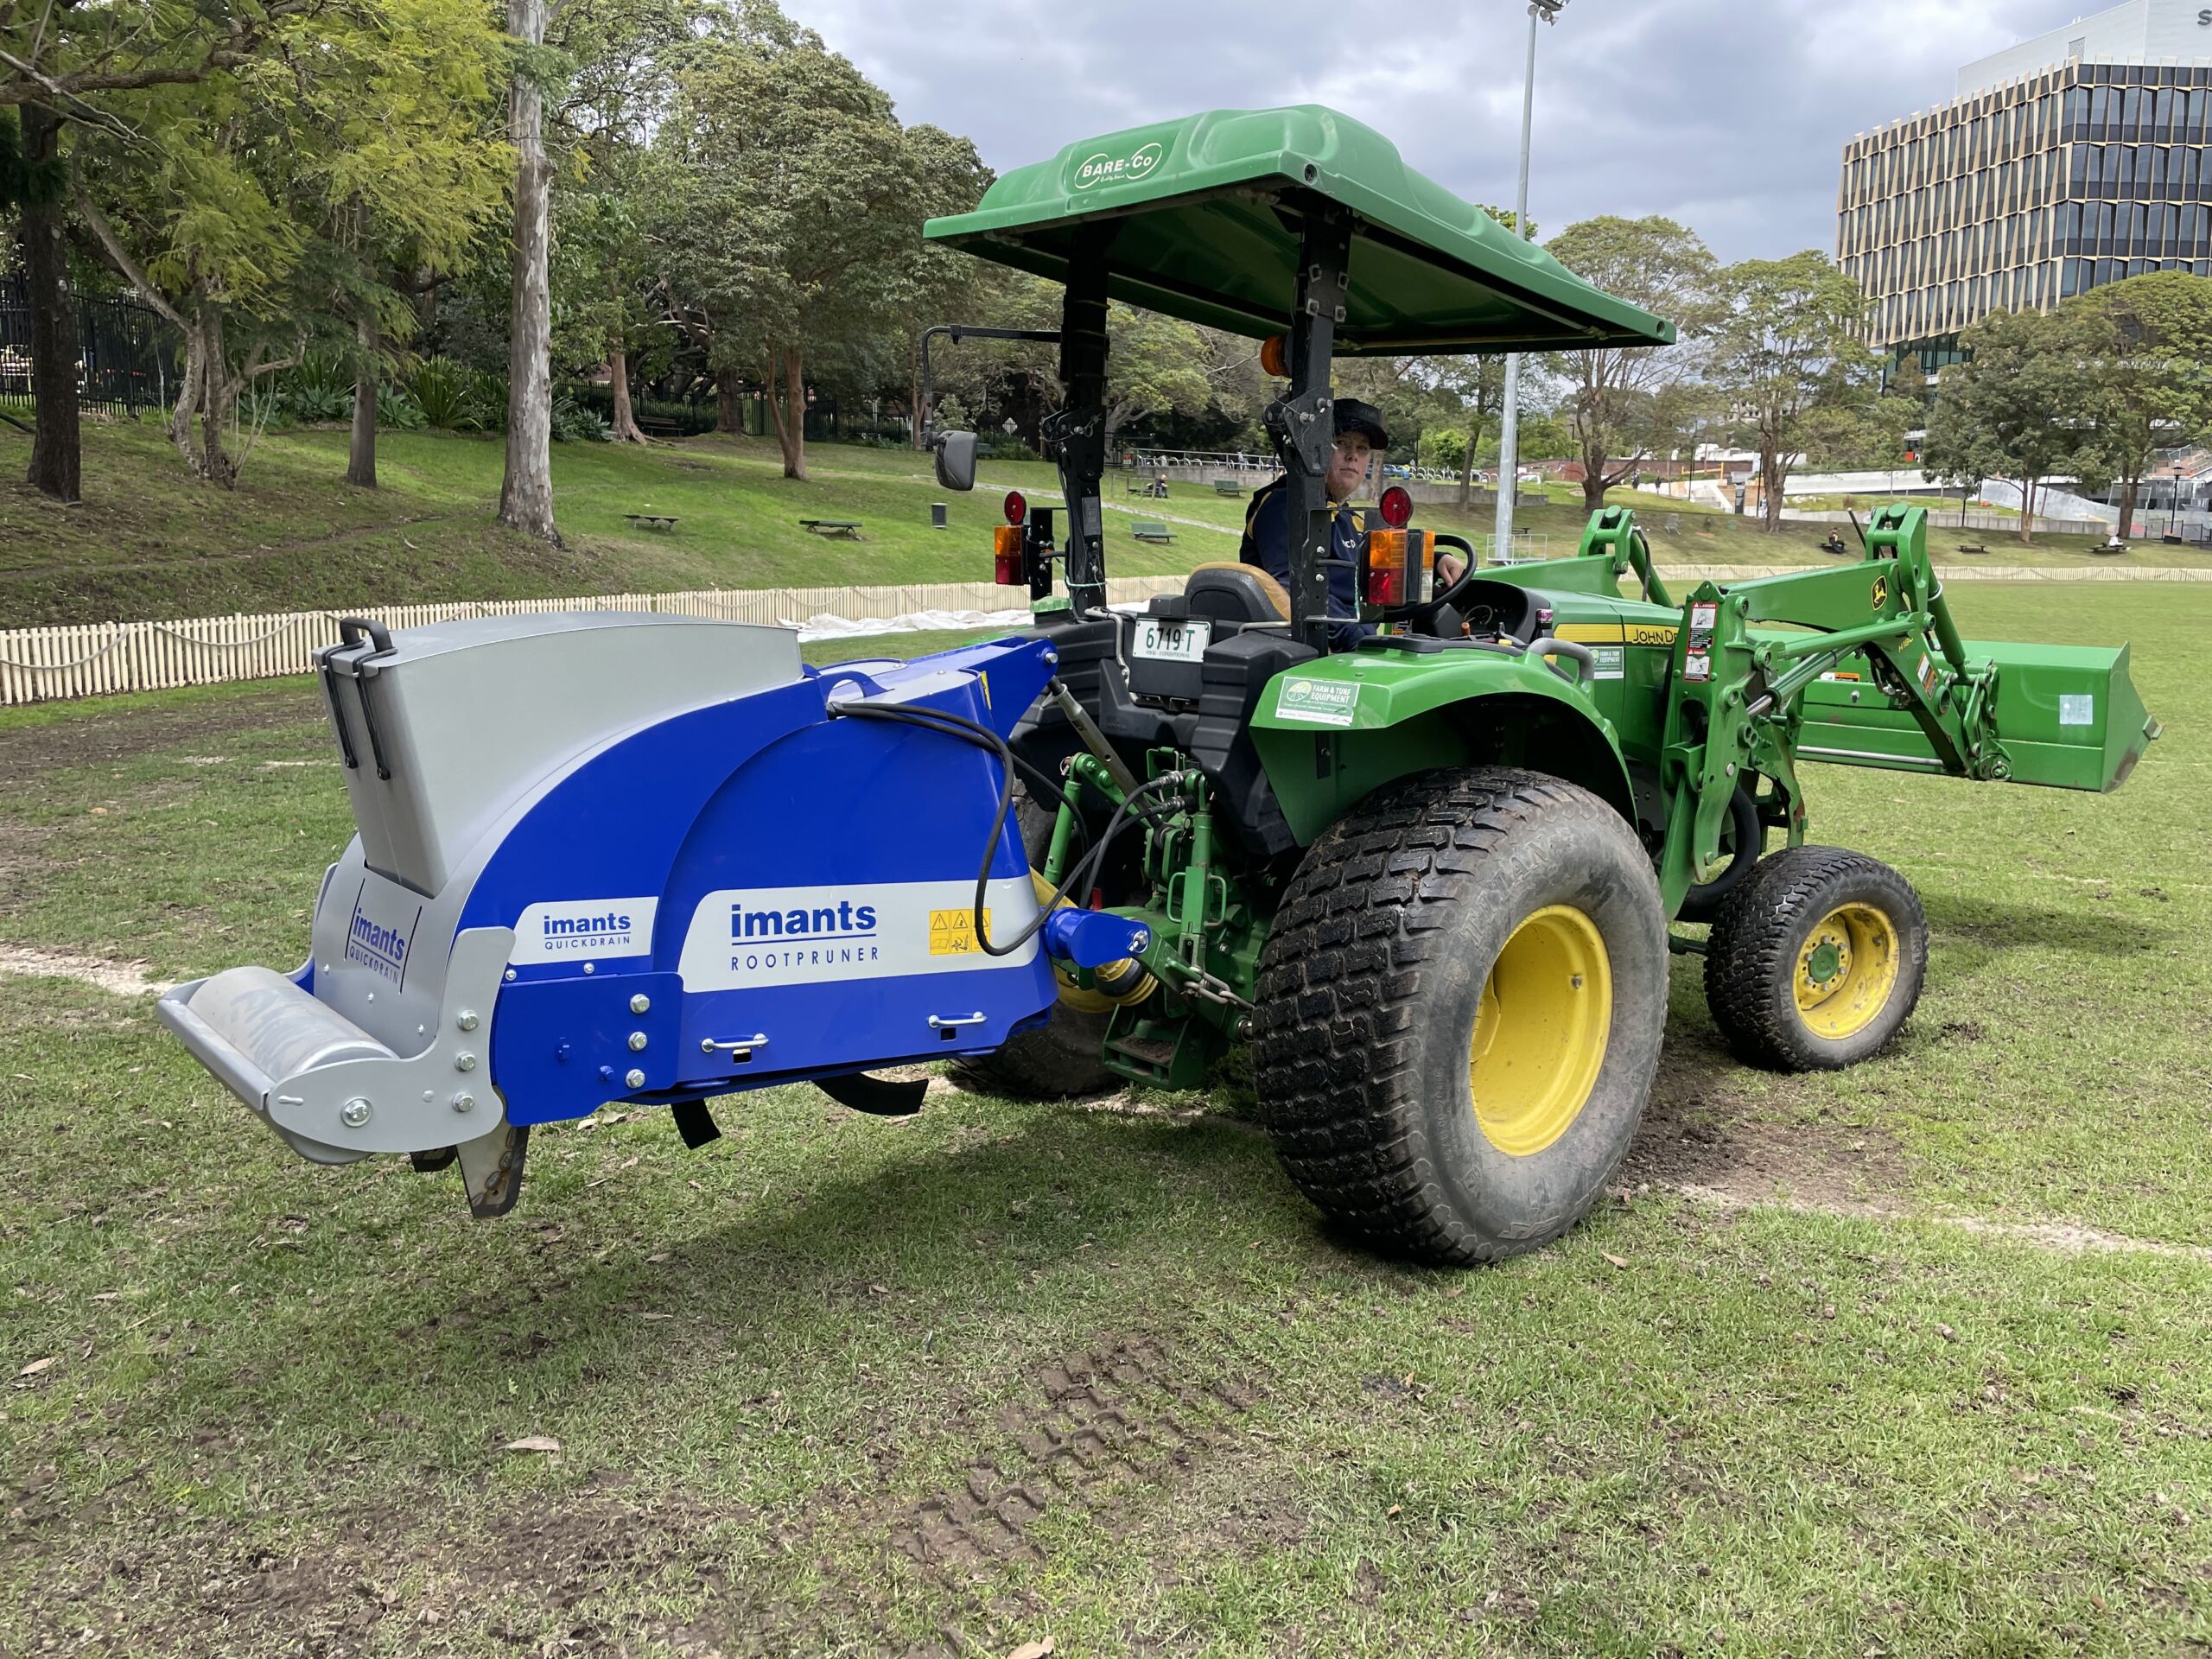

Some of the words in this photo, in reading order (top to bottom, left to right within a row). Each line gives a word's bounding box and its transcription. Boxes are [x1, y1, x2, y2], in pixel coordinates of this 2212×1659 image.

[1632, 628, 1664, 644] JOHN
[1311, 692, 1351, 704] EQUIPMENT
[1312, 684, 1331, 693] FARM
[1336, 687, 1351, 696] TURF
[543, 912, 631, 934] imants
[731, 900, 876, 938] imants
[353, 907, 404, 961] imants
[544, 935, 631, 950] QUICKDRAIN
[349, 945, 398, 984] QUICKDRAIN
[731, 946, 879, 972] ROOTPRUNER
